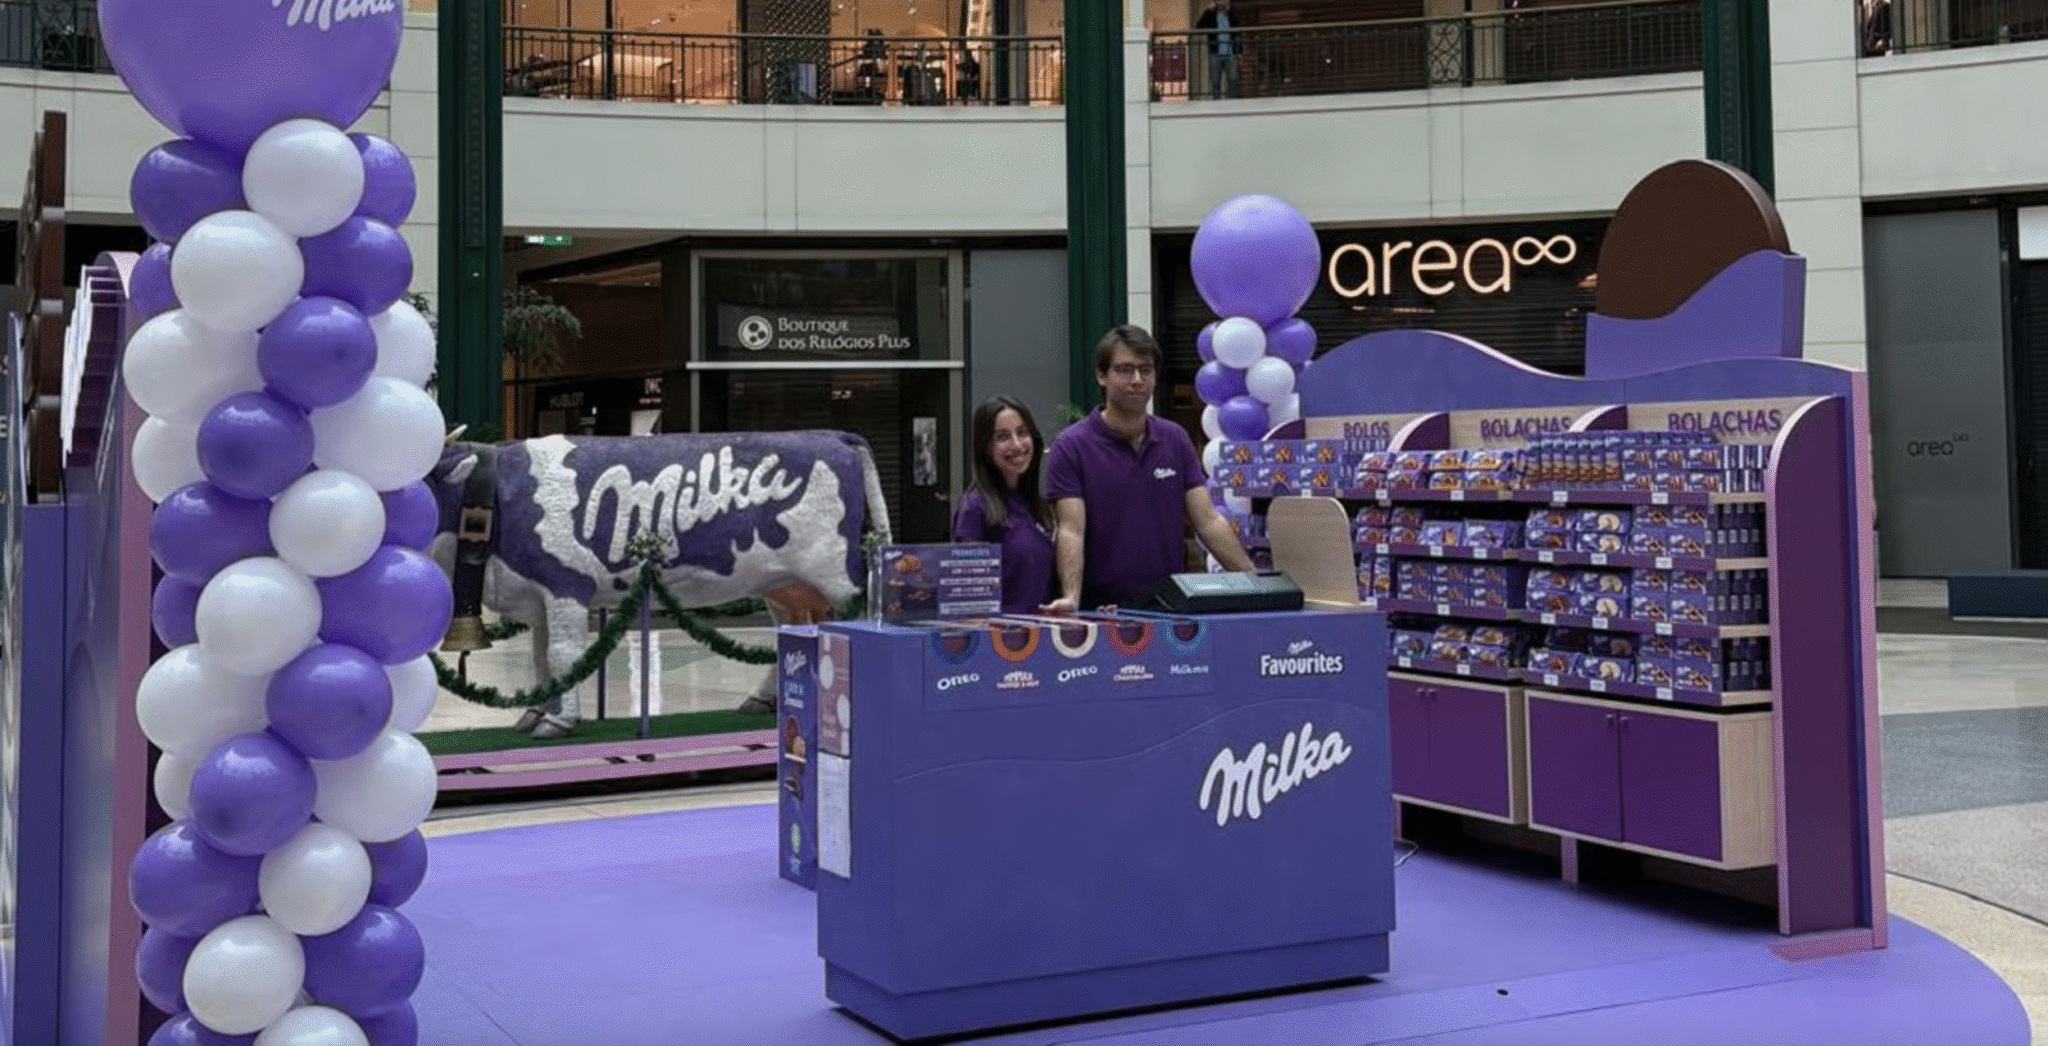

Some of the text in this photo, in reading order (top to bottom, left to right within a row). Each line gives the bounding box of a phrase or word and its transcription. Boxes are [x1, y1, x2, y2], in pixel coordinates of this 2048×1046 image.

[1343, 421, 1390, 439] BOLOS
[1480, 416, 1572, 439] BOLACHAS
[1668, 408, 1783, 433] BOLACHAS
[583, 446, 803, 564] Milka
[1057, 665, 1098, 683] OREO
[1260, 651, 1343, 677] Favourites
[937, 673, 980, 691] OREO
[1200, 722, 1352, 827] Milka
